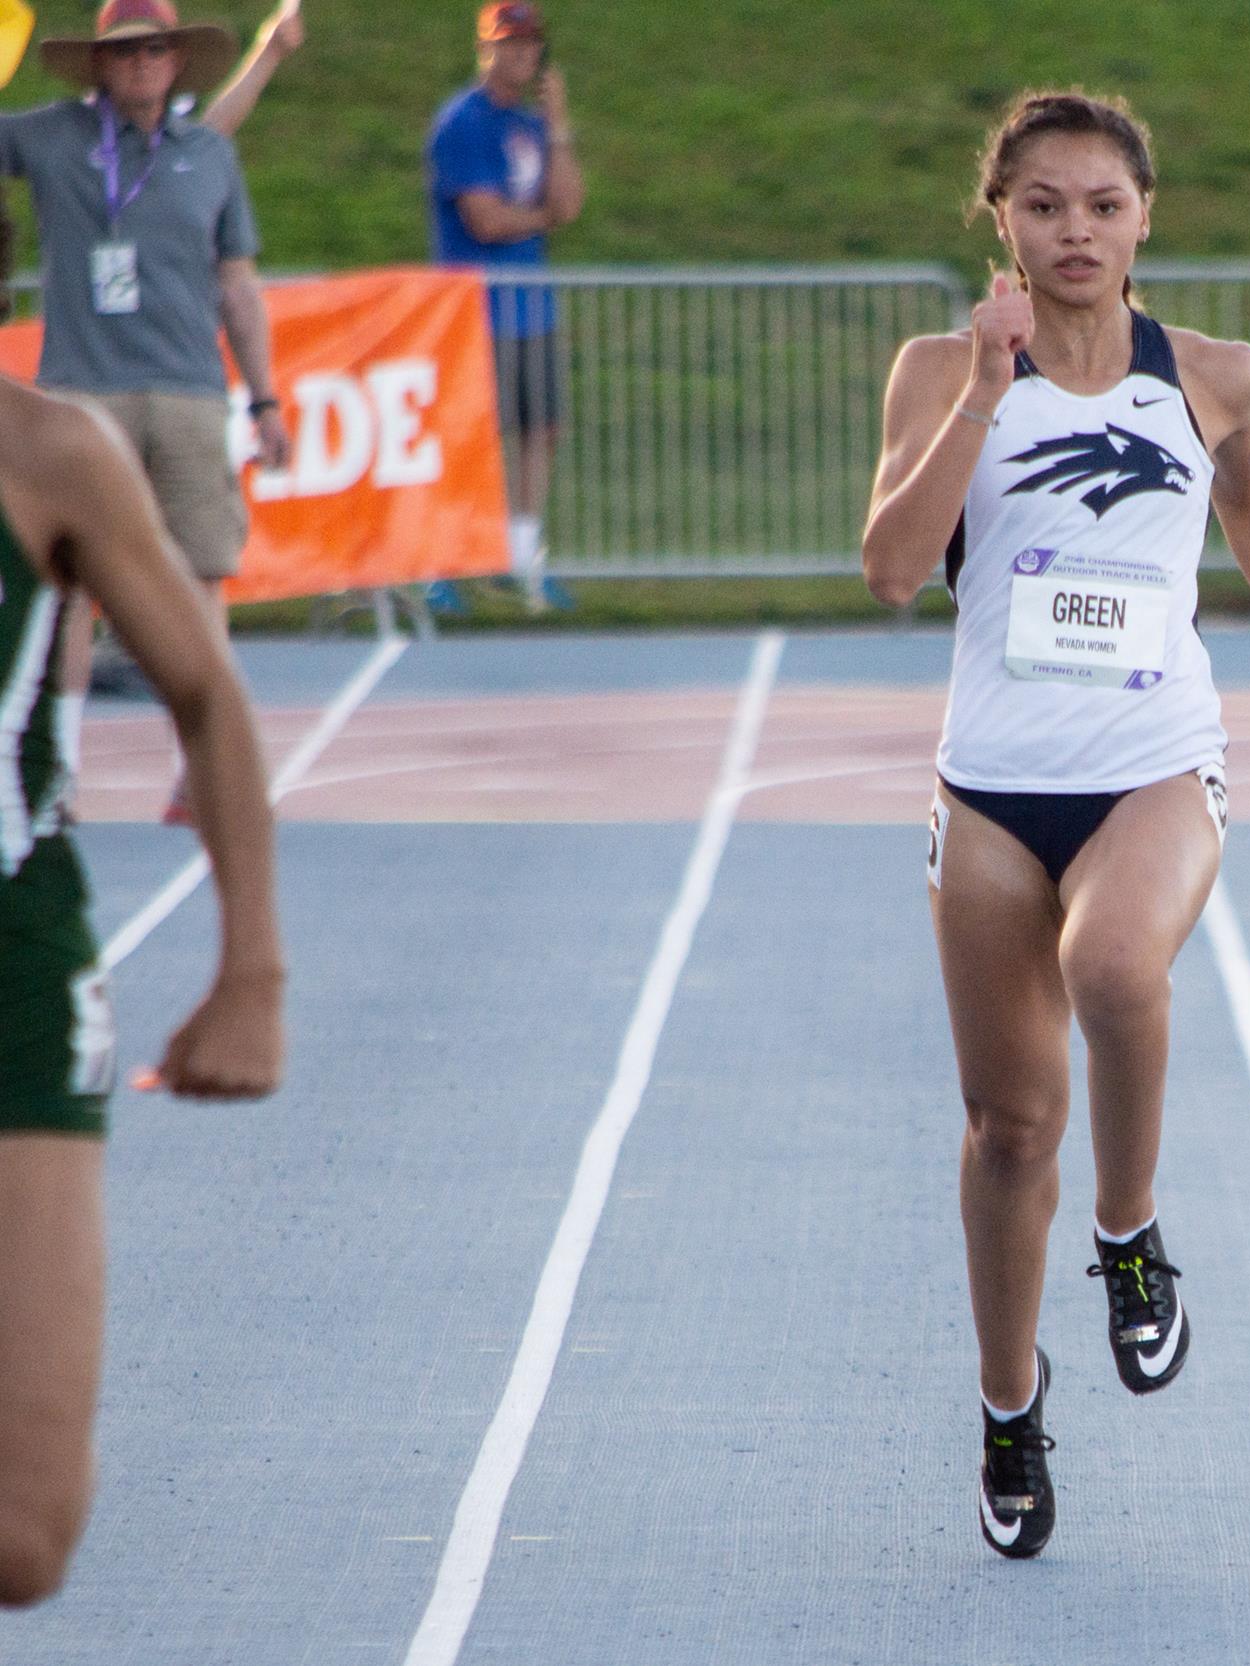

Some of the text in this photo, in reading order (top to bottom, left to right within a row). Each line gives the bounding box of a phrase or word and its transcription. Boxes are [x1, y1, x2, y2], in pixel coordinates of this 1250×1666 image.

[1053, 565, 1098, 575] OUTDOOR
[1100, 569, 1130, 580] TRACK
[1141, 574, 1167, 584] FIELD
[1052, 591, 1126, 630] GREEN
[1055, 636, 1117, 654] NEVADA WOMEN
[1078, 668, 1093, 678] CA
